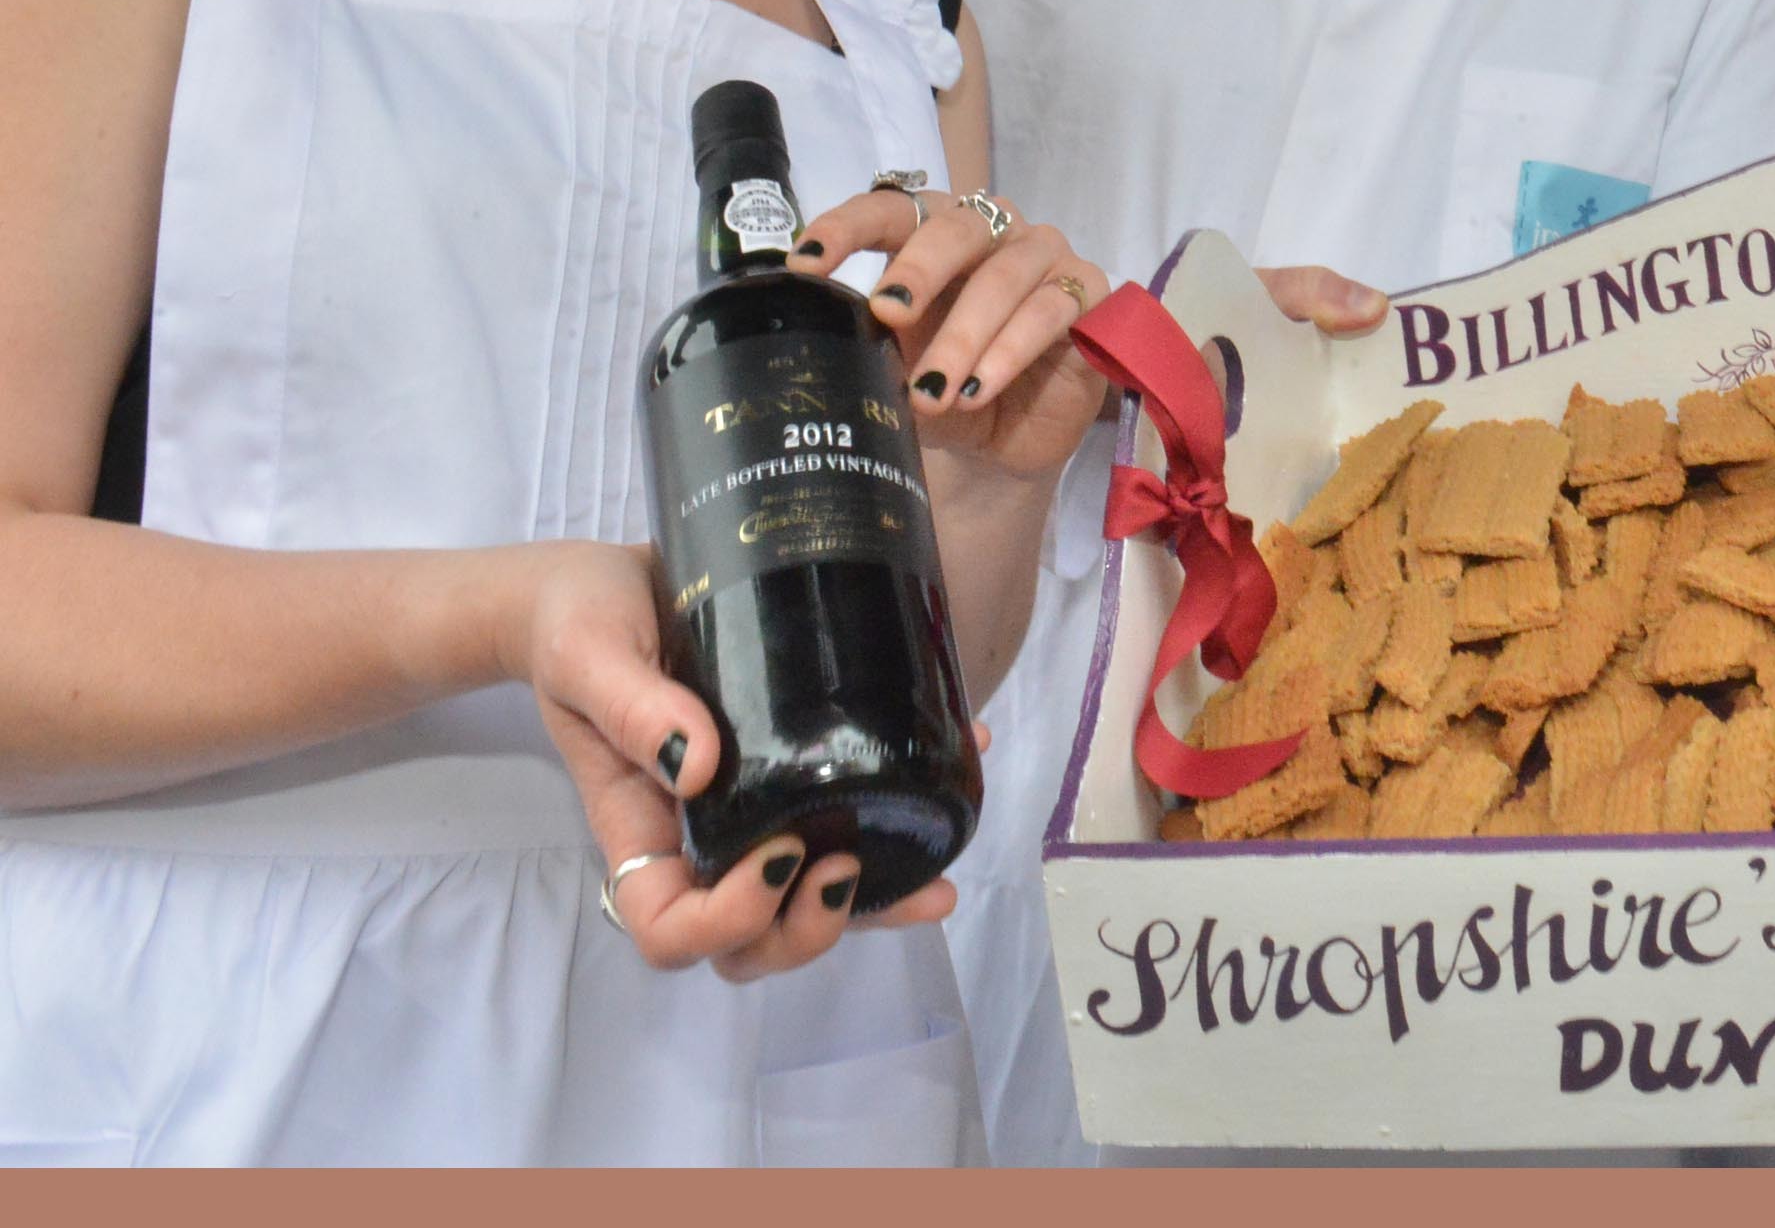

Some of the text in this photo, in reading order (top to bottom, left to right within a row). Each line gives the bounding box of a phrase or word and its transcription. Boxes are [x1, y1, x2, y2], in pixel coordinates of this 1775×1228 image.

[783, 422, 853, 449] 2012
[680, 476, 722, 518] LATE
[726, 453, 822, 492] BOTTLED
[826, 454, 904, 487] VINTAGE
